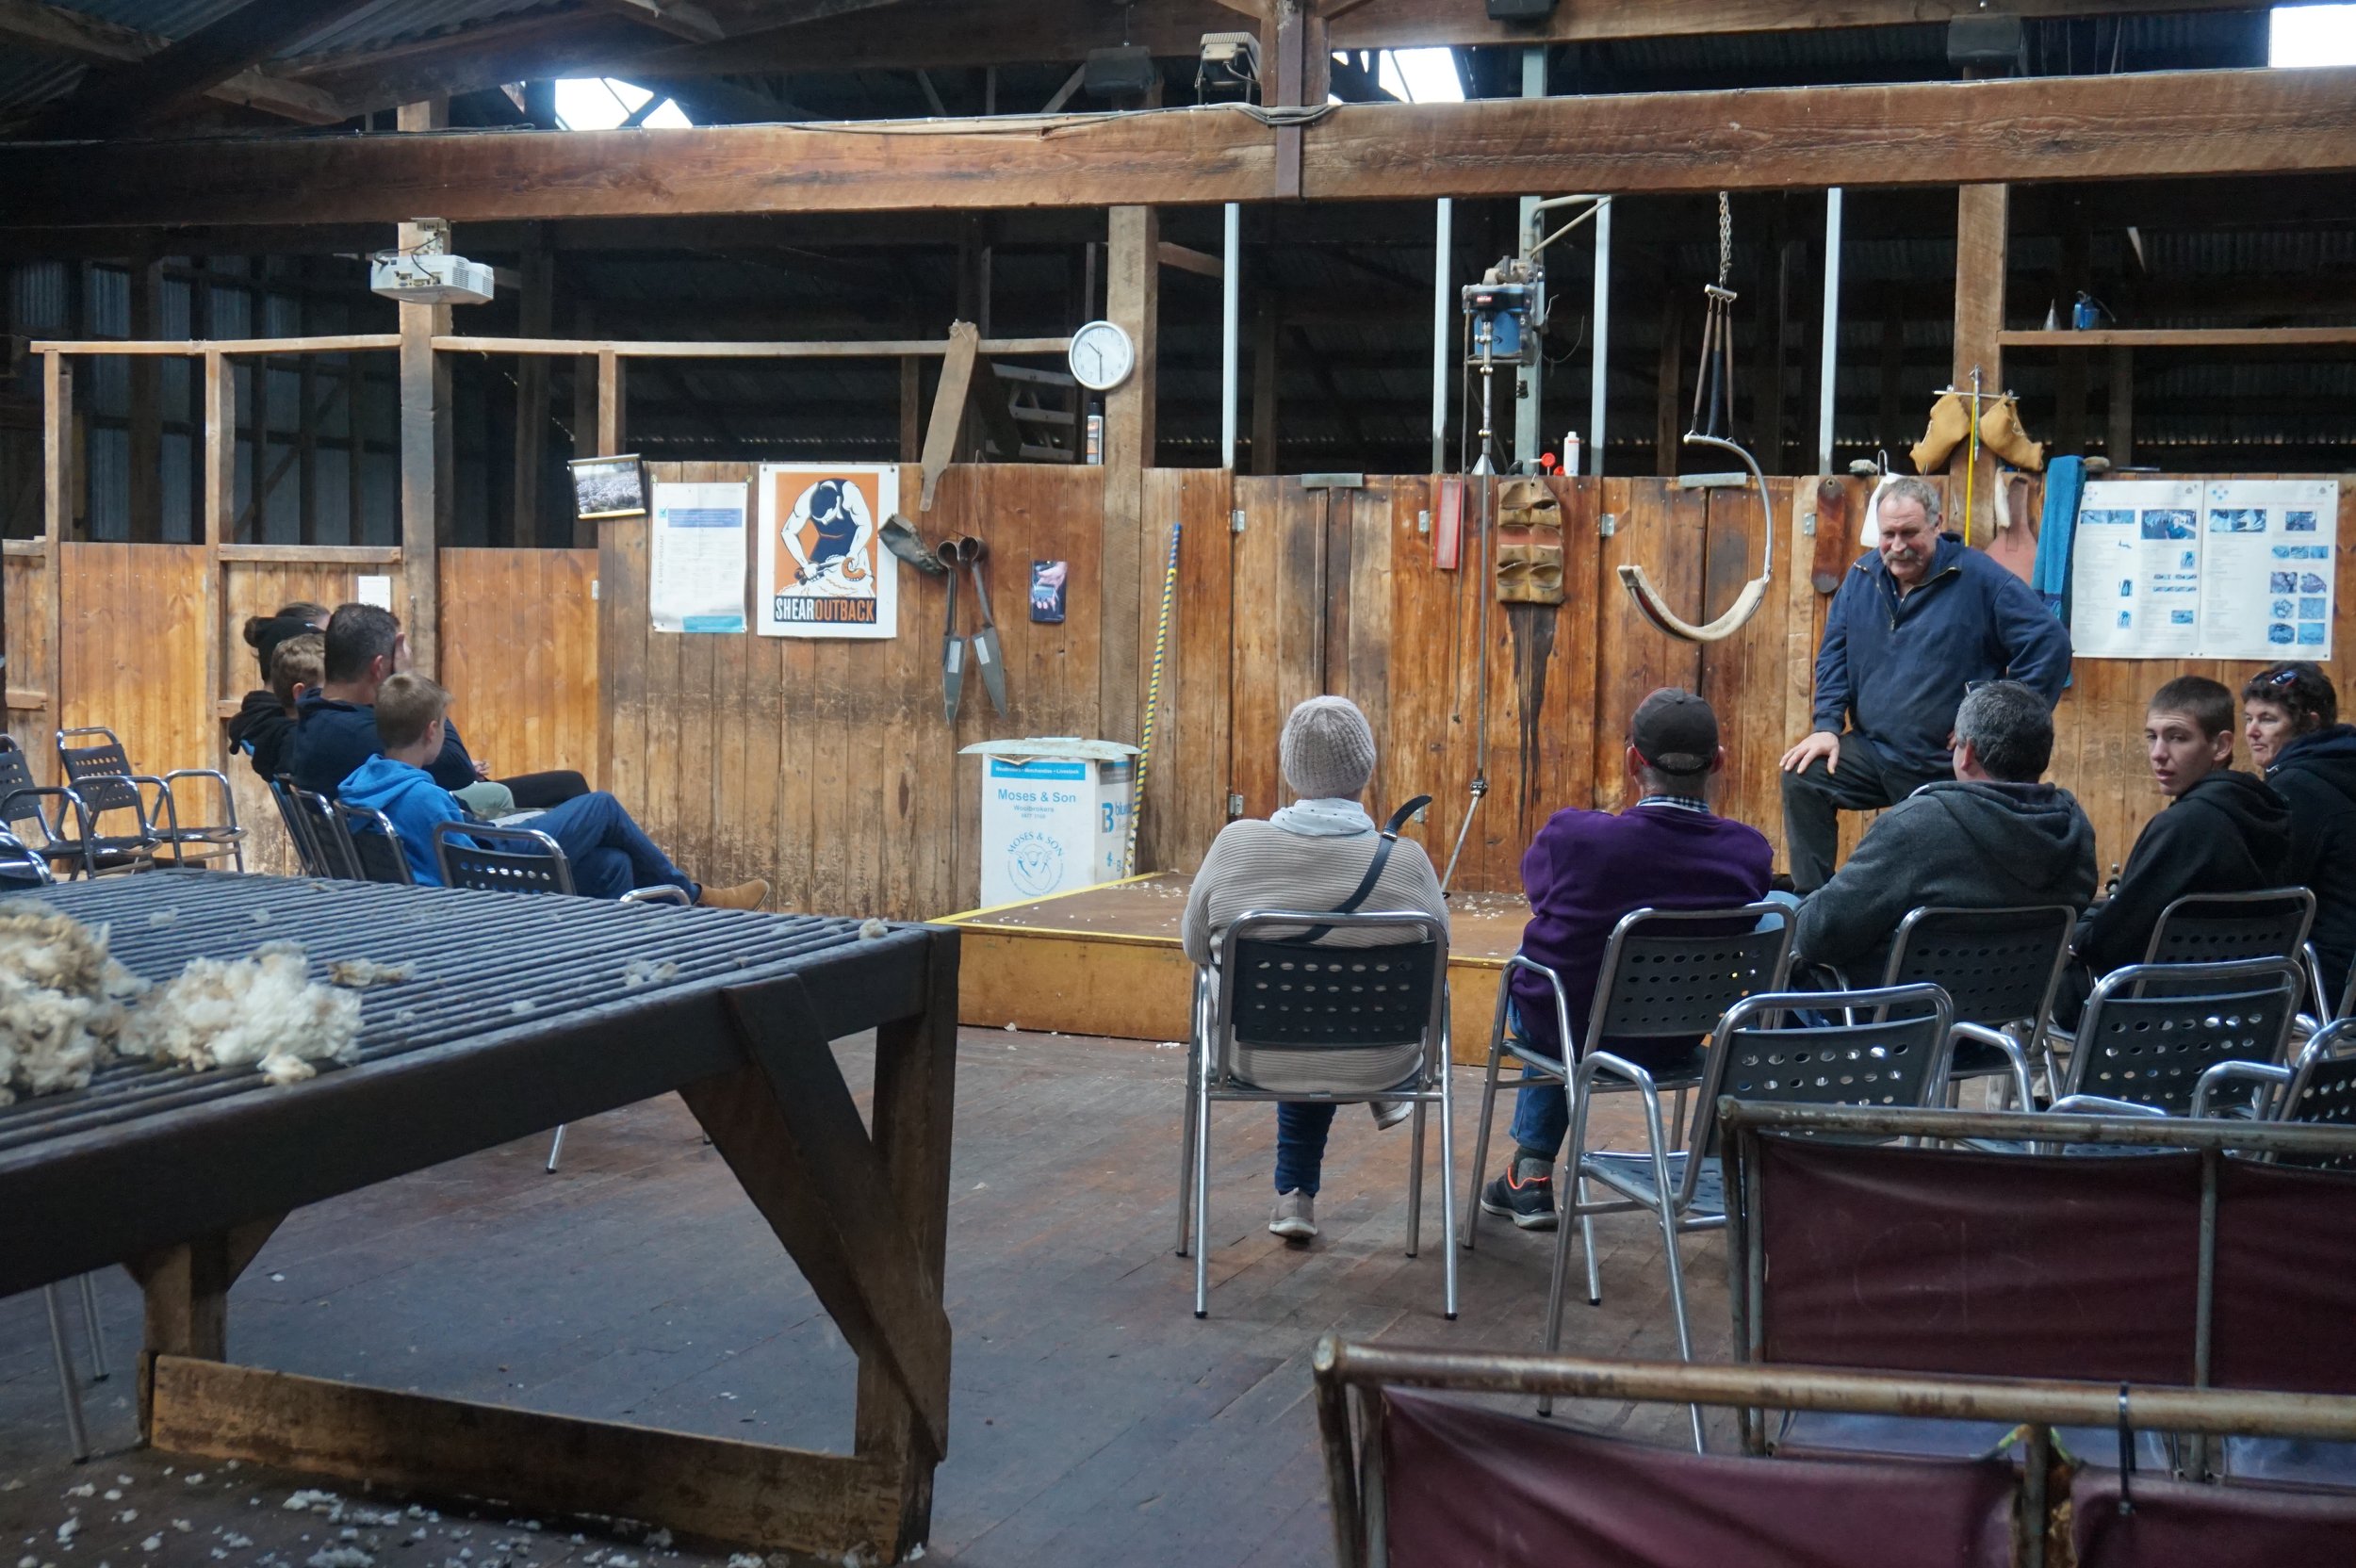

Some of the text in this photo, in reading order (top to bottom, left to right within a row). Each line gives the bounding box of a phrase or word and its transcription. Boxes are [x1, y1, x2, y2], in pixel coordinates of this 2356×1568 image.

[998, 789, 1076, 803] Moses & Son
[1007, 831, 1034, 854] MOSES
[1046, 837, 1063, 857] SON
